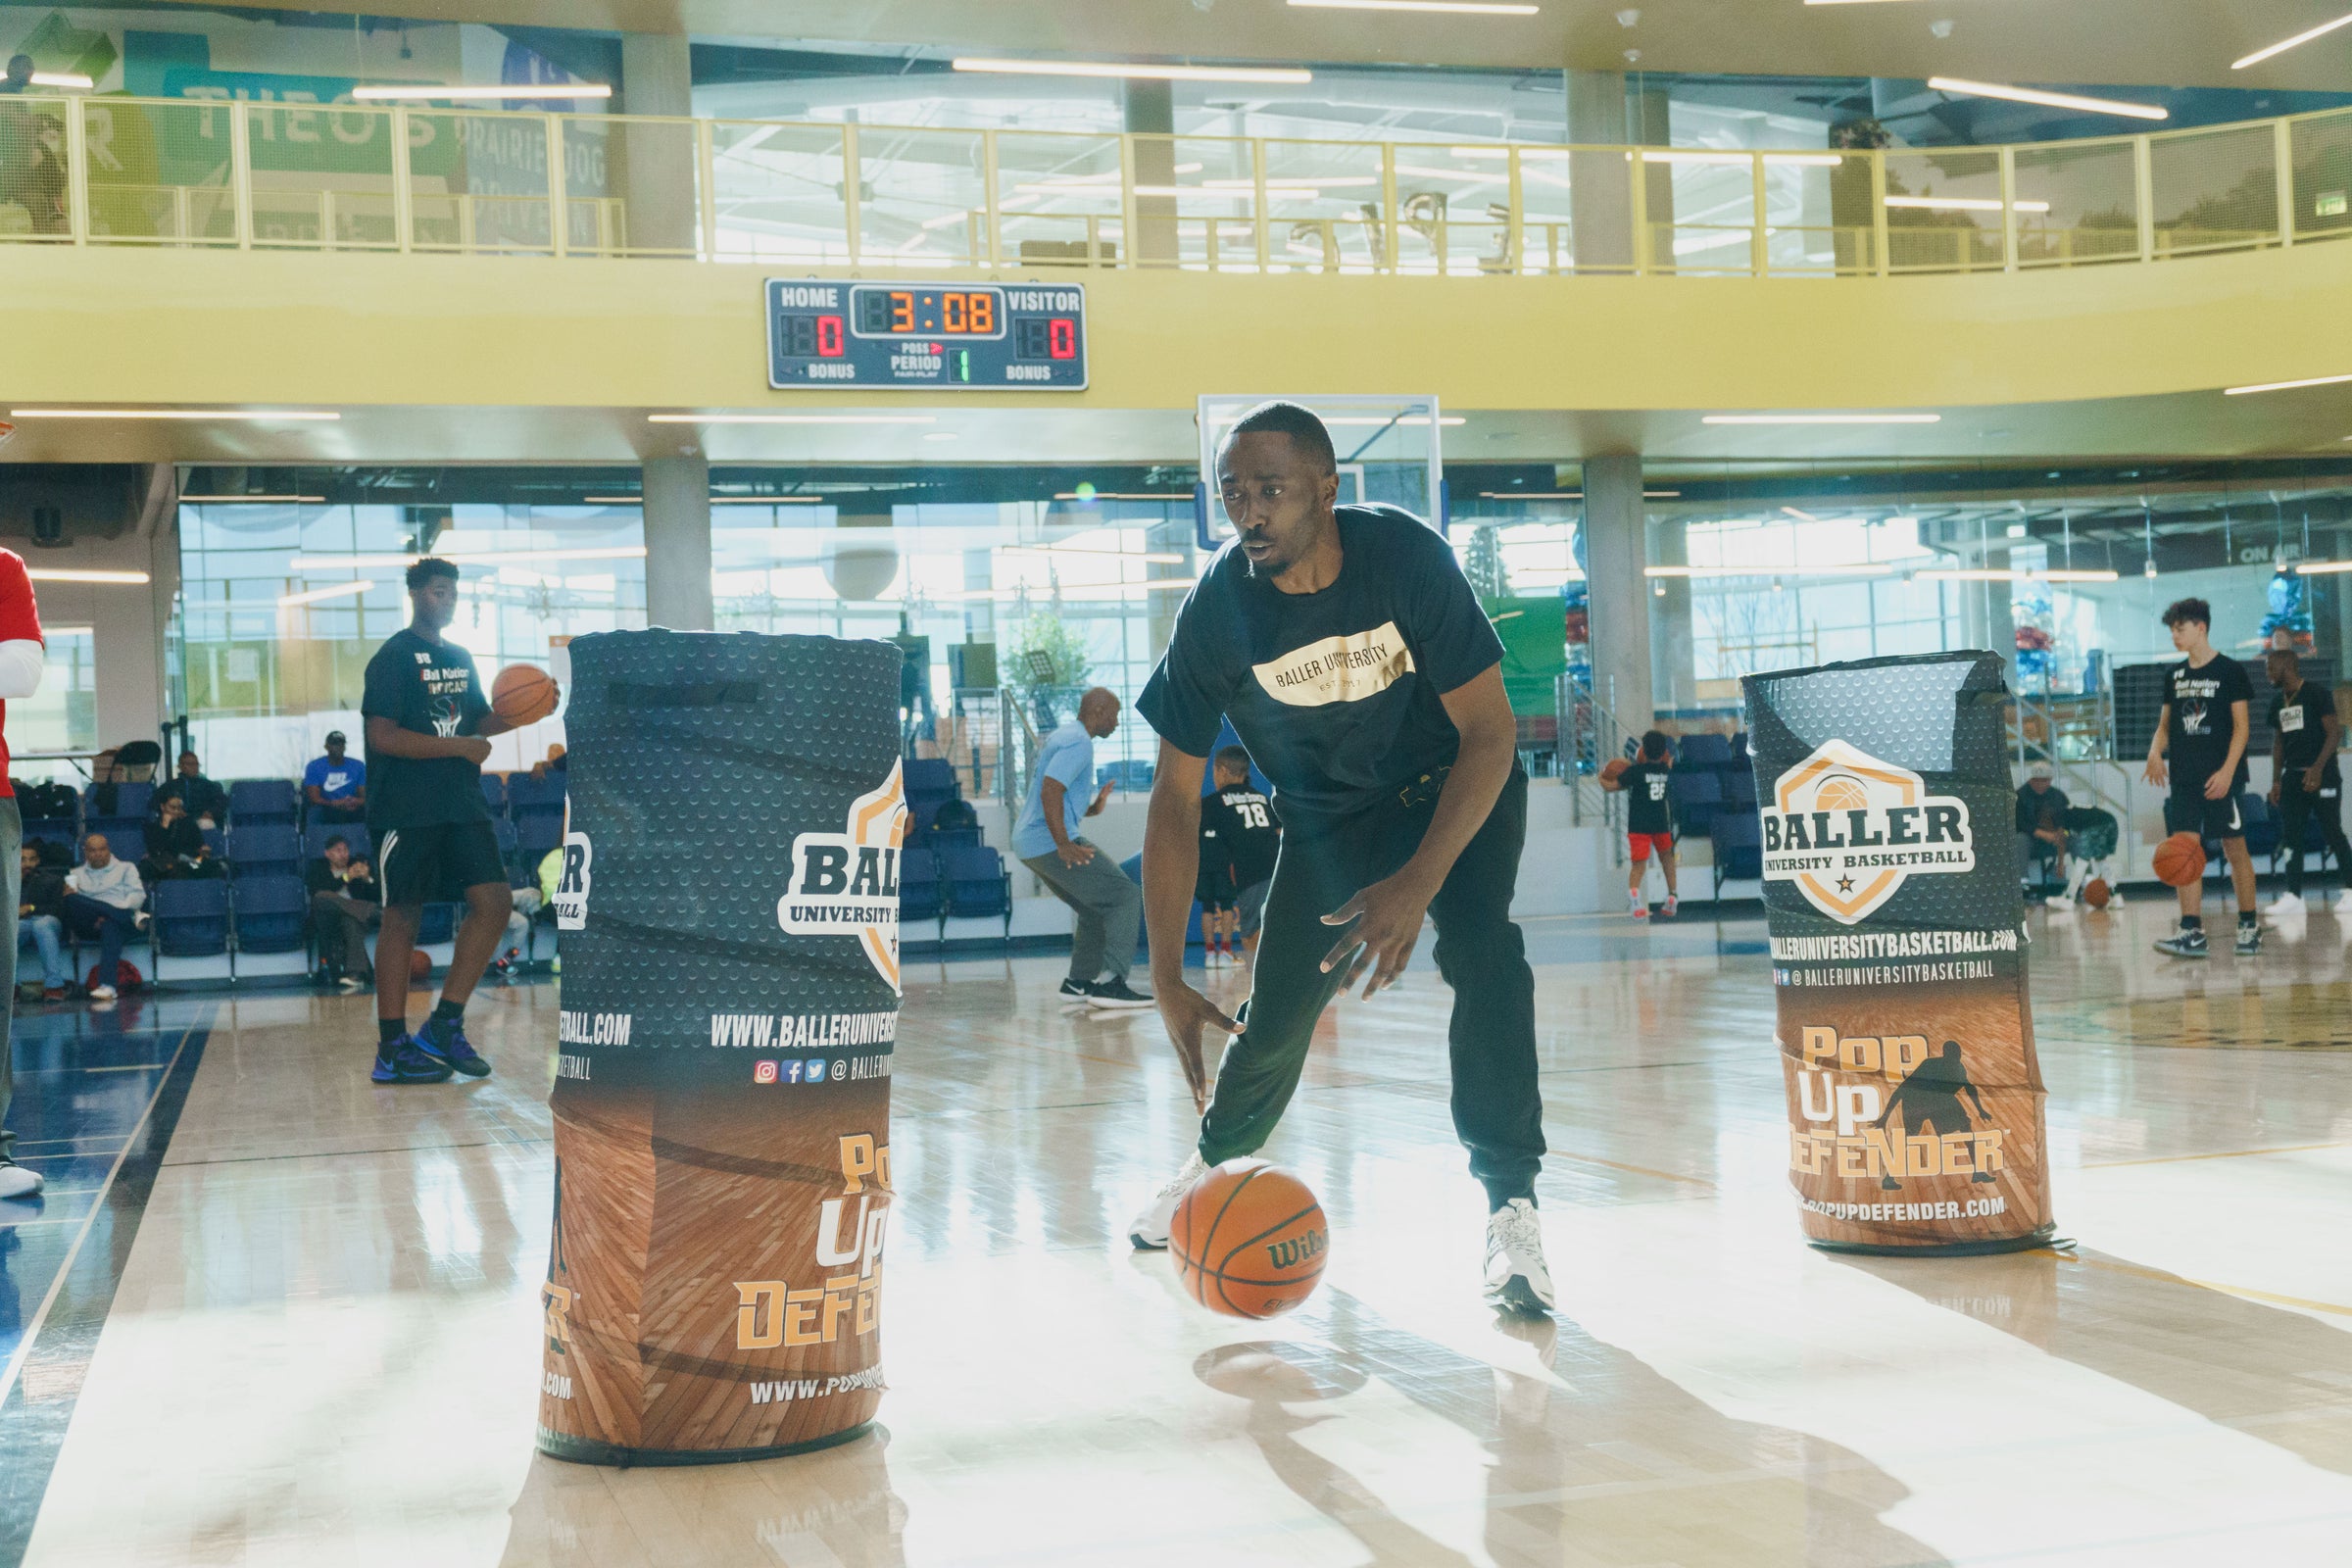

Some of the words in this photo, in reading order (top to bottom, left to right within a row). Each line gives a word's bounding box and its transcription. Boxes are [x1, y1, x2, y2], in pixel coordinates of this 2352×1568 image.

[781, 287, 839, 308] HOME
[1006, 291, 1081, 313] VISITOR
[890, 291, 994, 333] 3:08
[816, 315, 845, 358] 0
[1049, 318, 1076, 360] 0
[902, 342, 930, 355] POSS
[808, 364, 856, 378] BONUS
[890, 355, 942, 370] PERIOD
[1005, 366, 1052, 380] BONUS
[2240, 544, 2269, 564] ON
[1275, 660, 1323, 688] BALLER
[1235, 803, 1270, 830] 78
[1764, 805, 1965, 853] BALLER
[1842, 850, 1968, 869] BASKETBALL
[801, 845, 900, 898] BAL
[789, 905, 892, 924] UNIVERSITY
